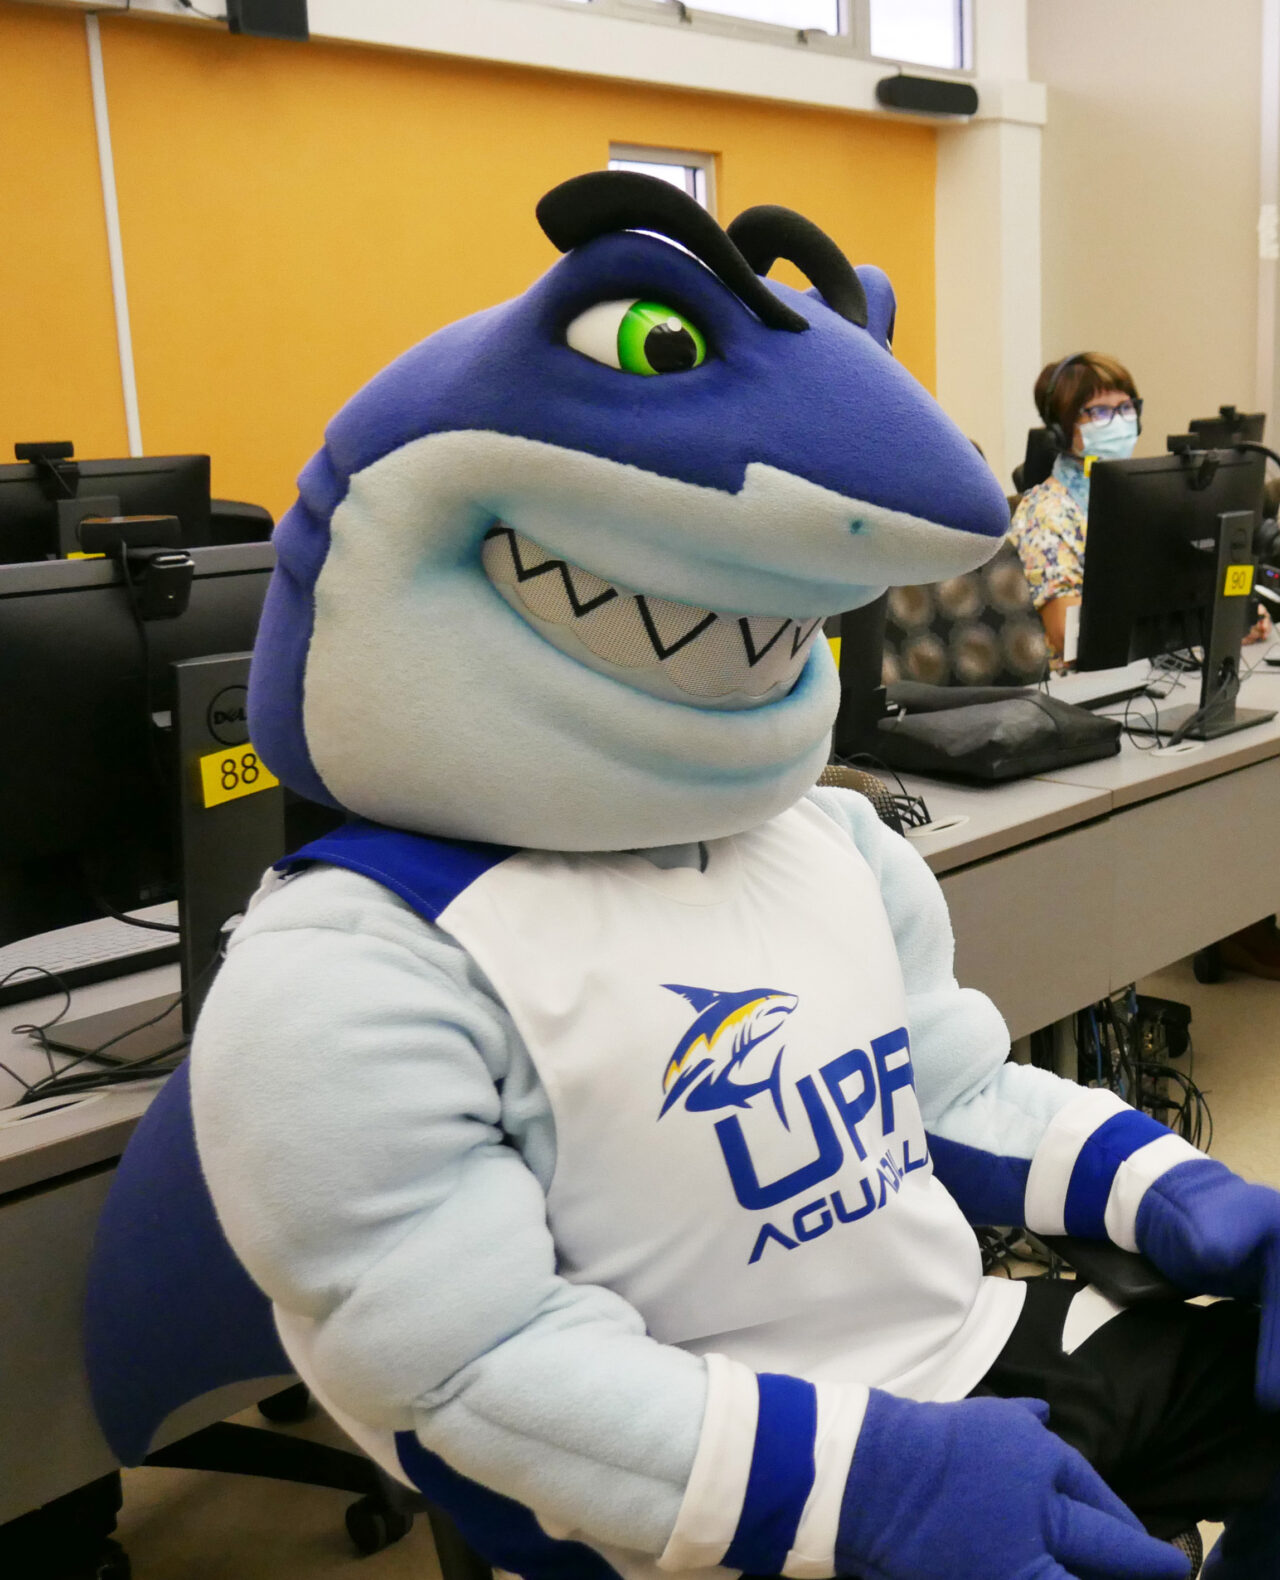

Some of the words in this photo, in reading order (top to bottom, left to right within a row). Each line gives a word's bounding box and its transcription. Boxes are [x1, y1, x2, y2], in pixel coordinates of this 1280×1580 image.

[1231, 571, 1247, 590] 90
[214, 707, 248, 725] DEL
[221, 753, 259, 790] 88
